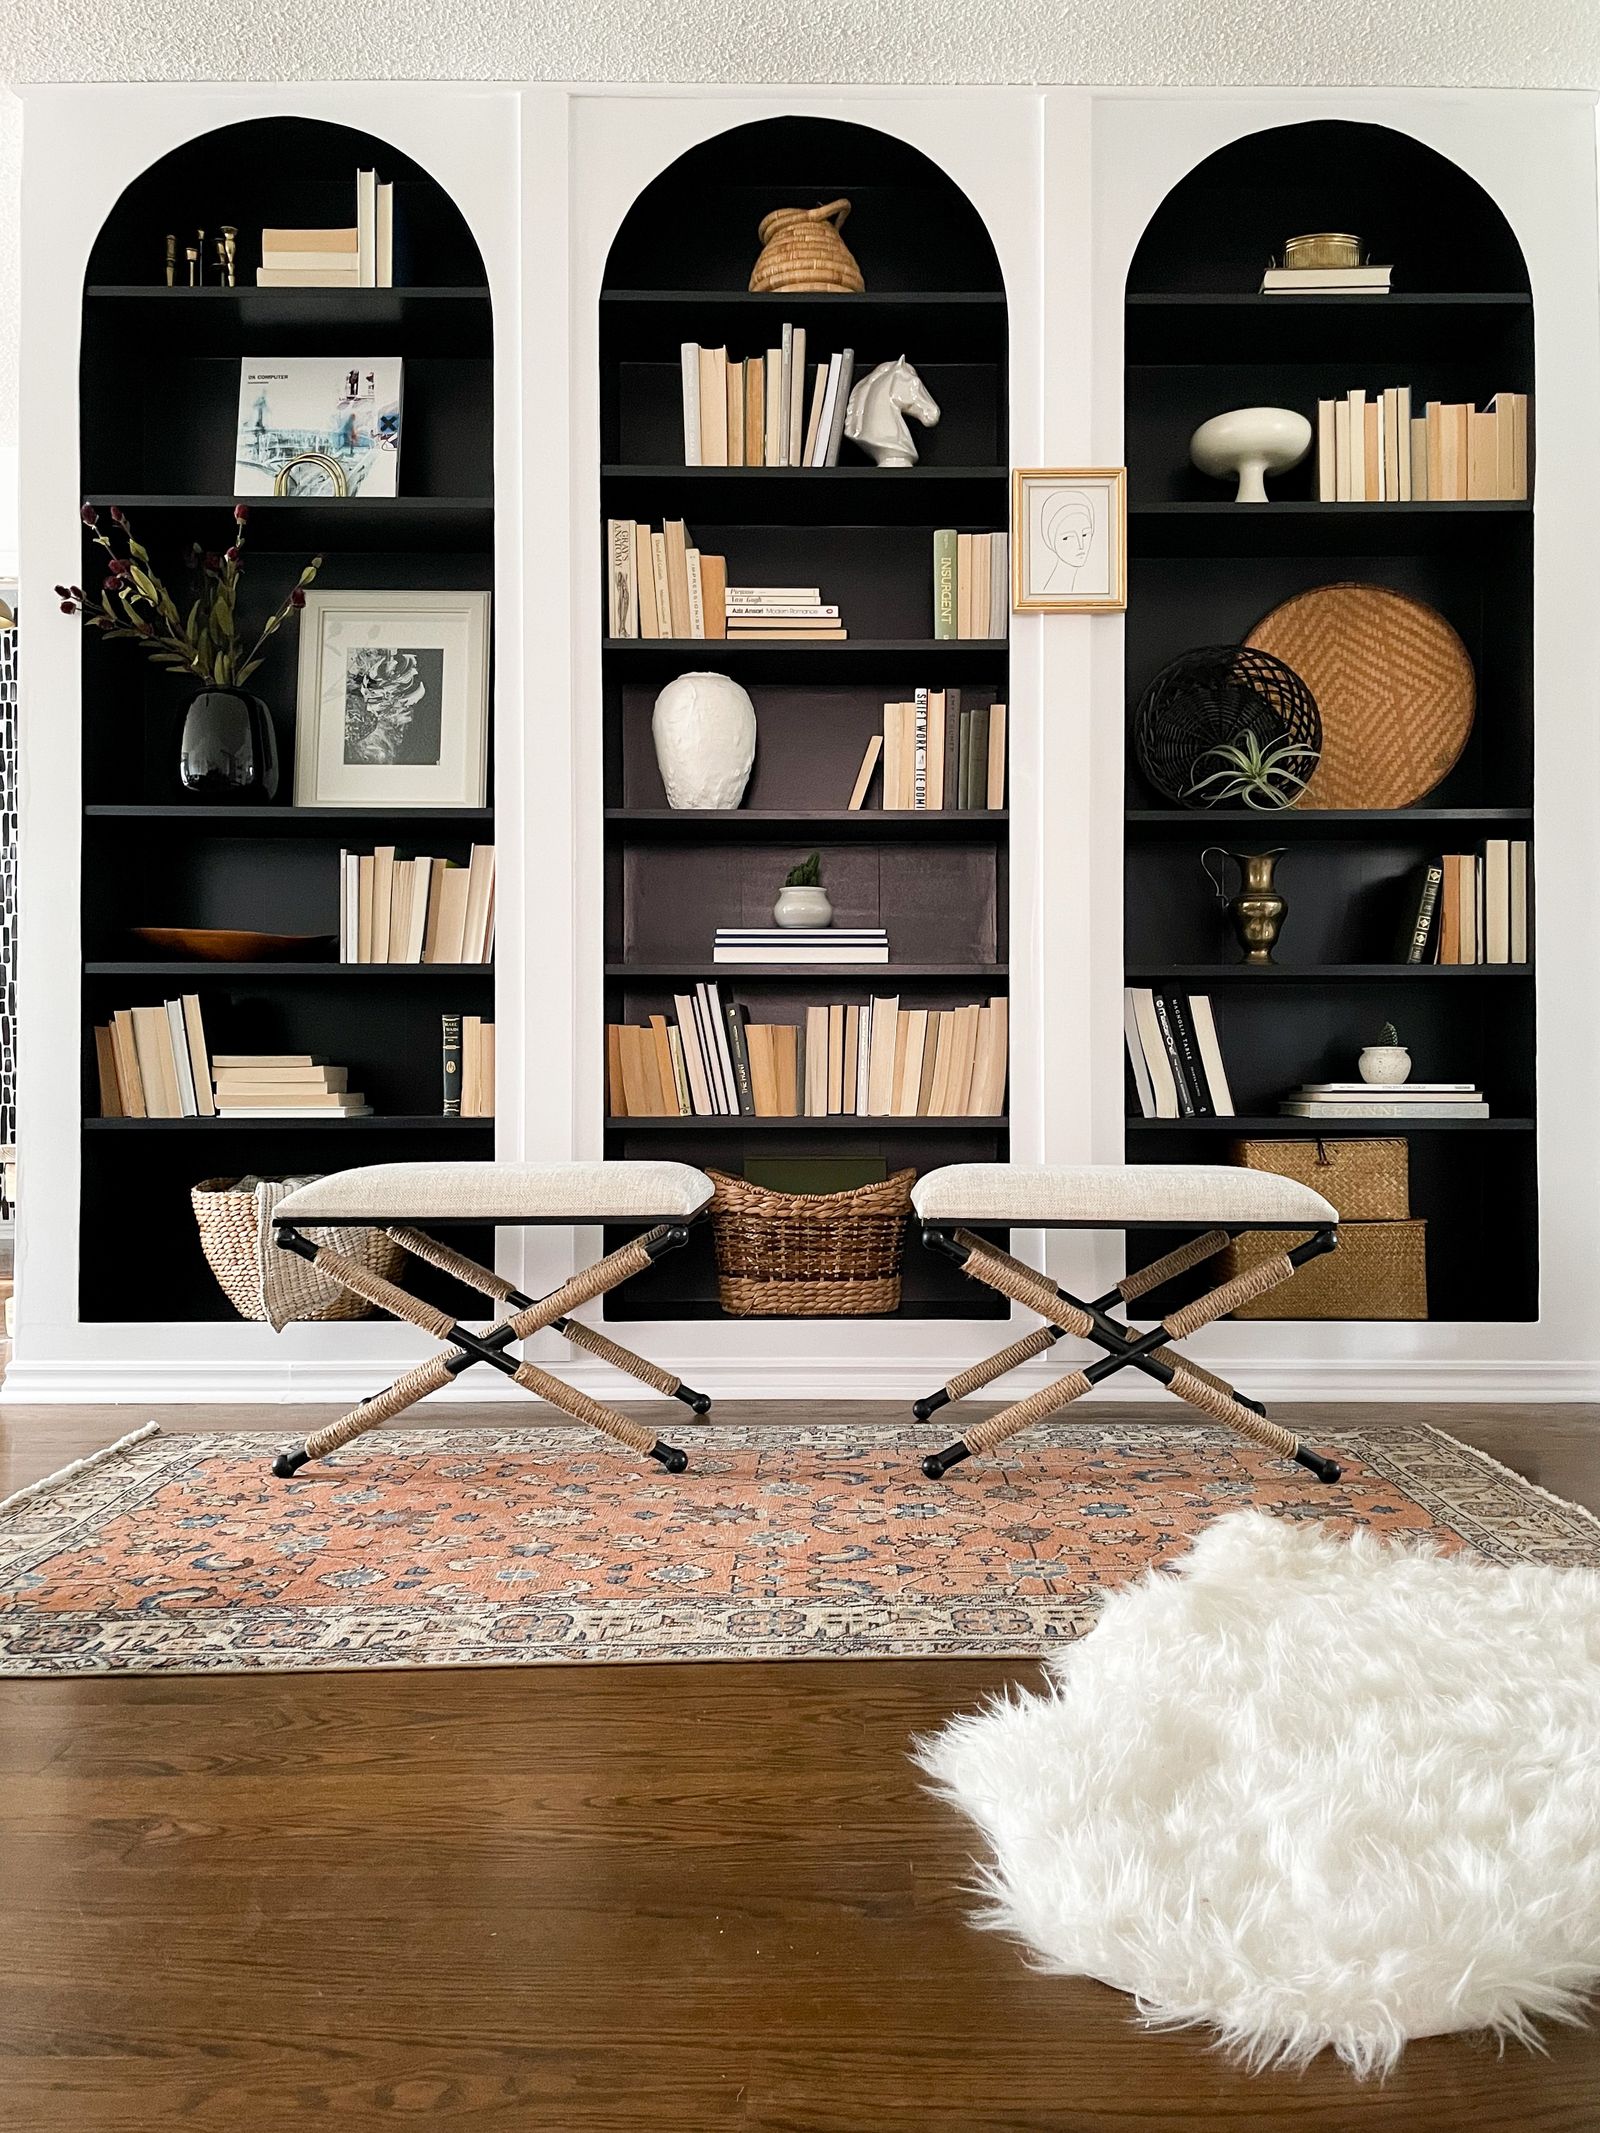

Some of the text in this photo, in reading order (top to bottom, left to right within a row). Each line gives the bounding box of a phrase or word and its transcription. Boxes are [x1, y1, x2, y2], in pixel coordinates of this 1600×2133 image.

[614, 522, 623, 569] ANATOMY
[691, 562, 700, 631] IMPRESSIONISM
[941, 557, 952, 625] INSURGENT
[916, 694, 926, 720] SHIFT
[915, 725, 926, 751] WORK
[915, 768, 926, 782] TIE
[915, 786, 925, 809] DOMI
[1172, 999, 1186, 1037] MAGNOLIA
[1182, 1038, 1193, 1060] TABLE
[738, 1063, 749, 1094] THE HUNT
[1321, 1104, 1402, 1117] CZANNE
